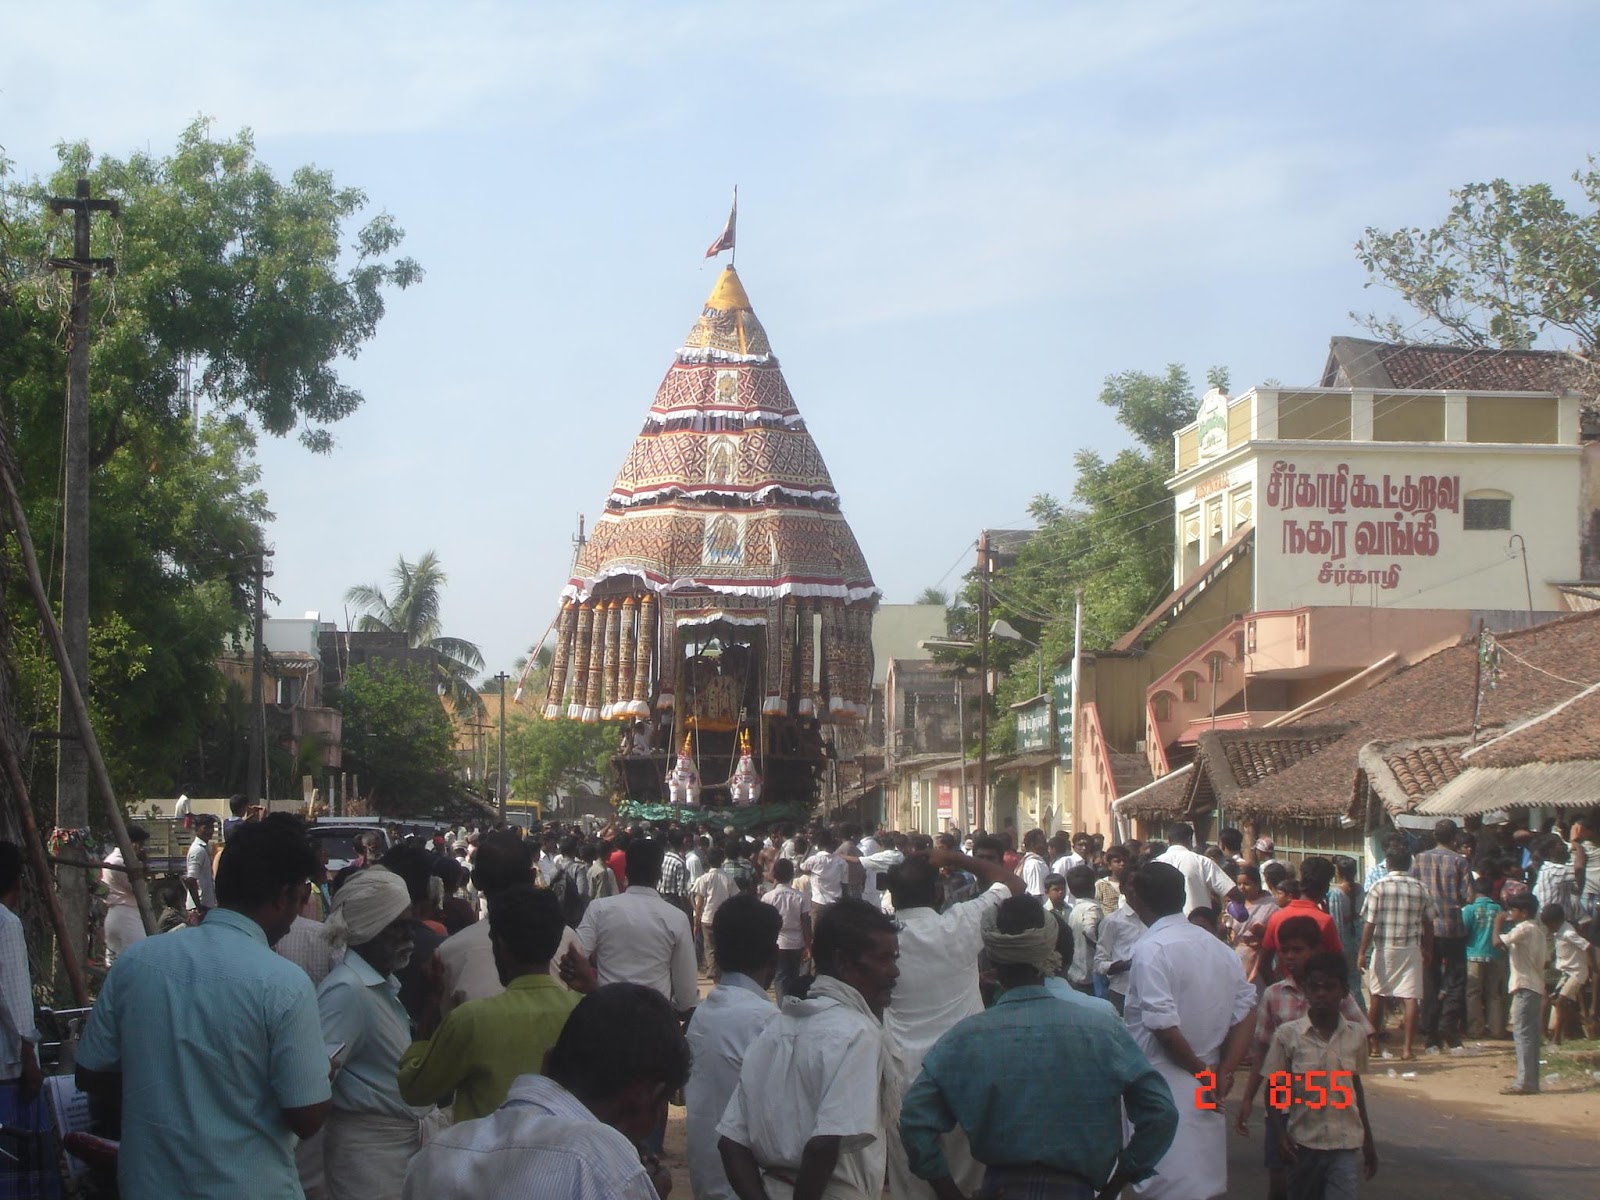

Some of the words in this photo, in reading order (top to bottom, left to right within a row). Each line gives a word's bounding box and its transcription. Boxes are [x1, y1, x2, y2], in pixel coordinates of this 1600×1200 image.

[1282, 519, 1348, 561] நகர
[1355, 511, 1439, 556] வங்கி
[1317, 561, 1402, 589] சீர்காழி
